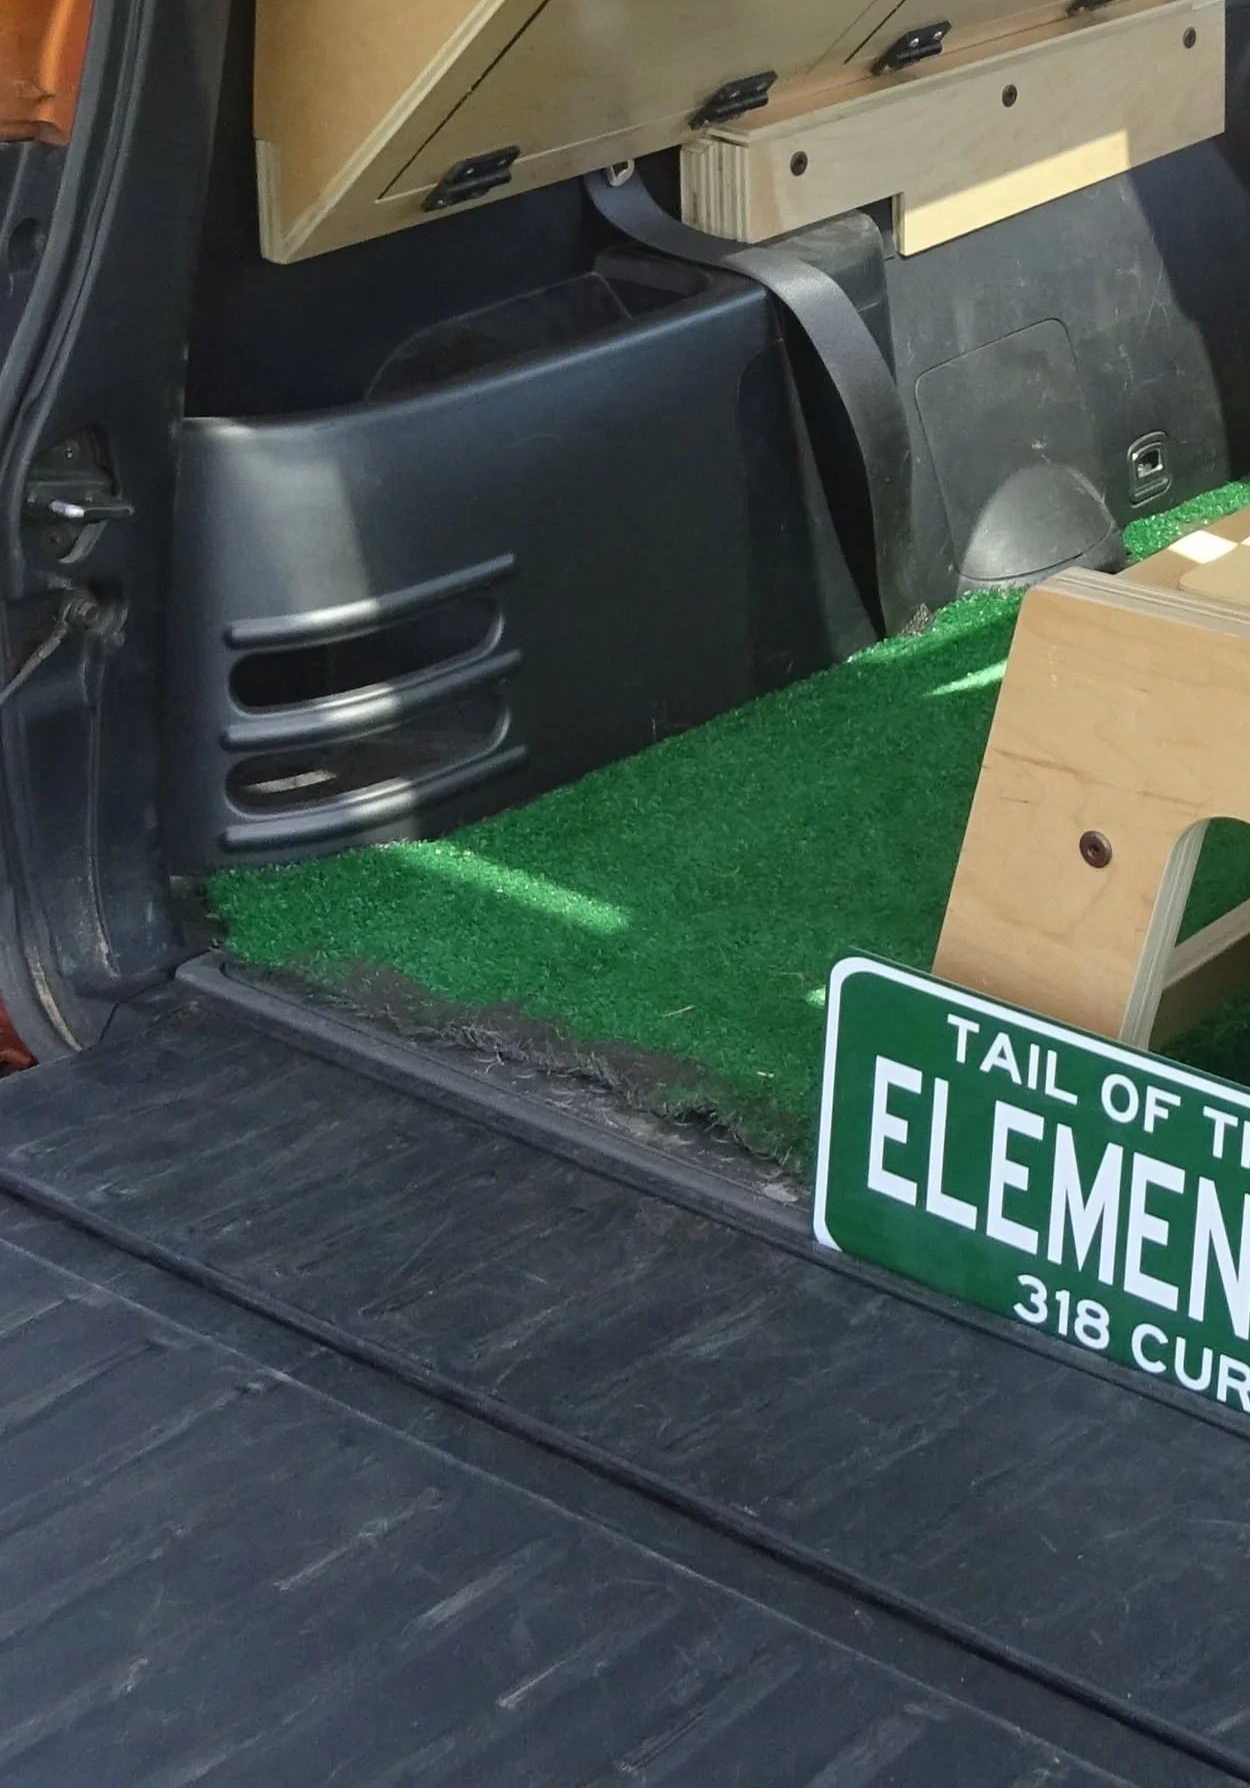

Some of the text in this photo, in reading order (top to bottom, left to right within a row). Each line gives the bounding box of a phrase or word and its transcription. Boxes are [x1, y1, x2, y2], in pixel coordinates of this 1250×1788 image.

[947, 1013, 1078, 1105] TAIL
[1101, 1073, 1181, 1133] OF
[1013, 1274, 1110, 1350] 318
